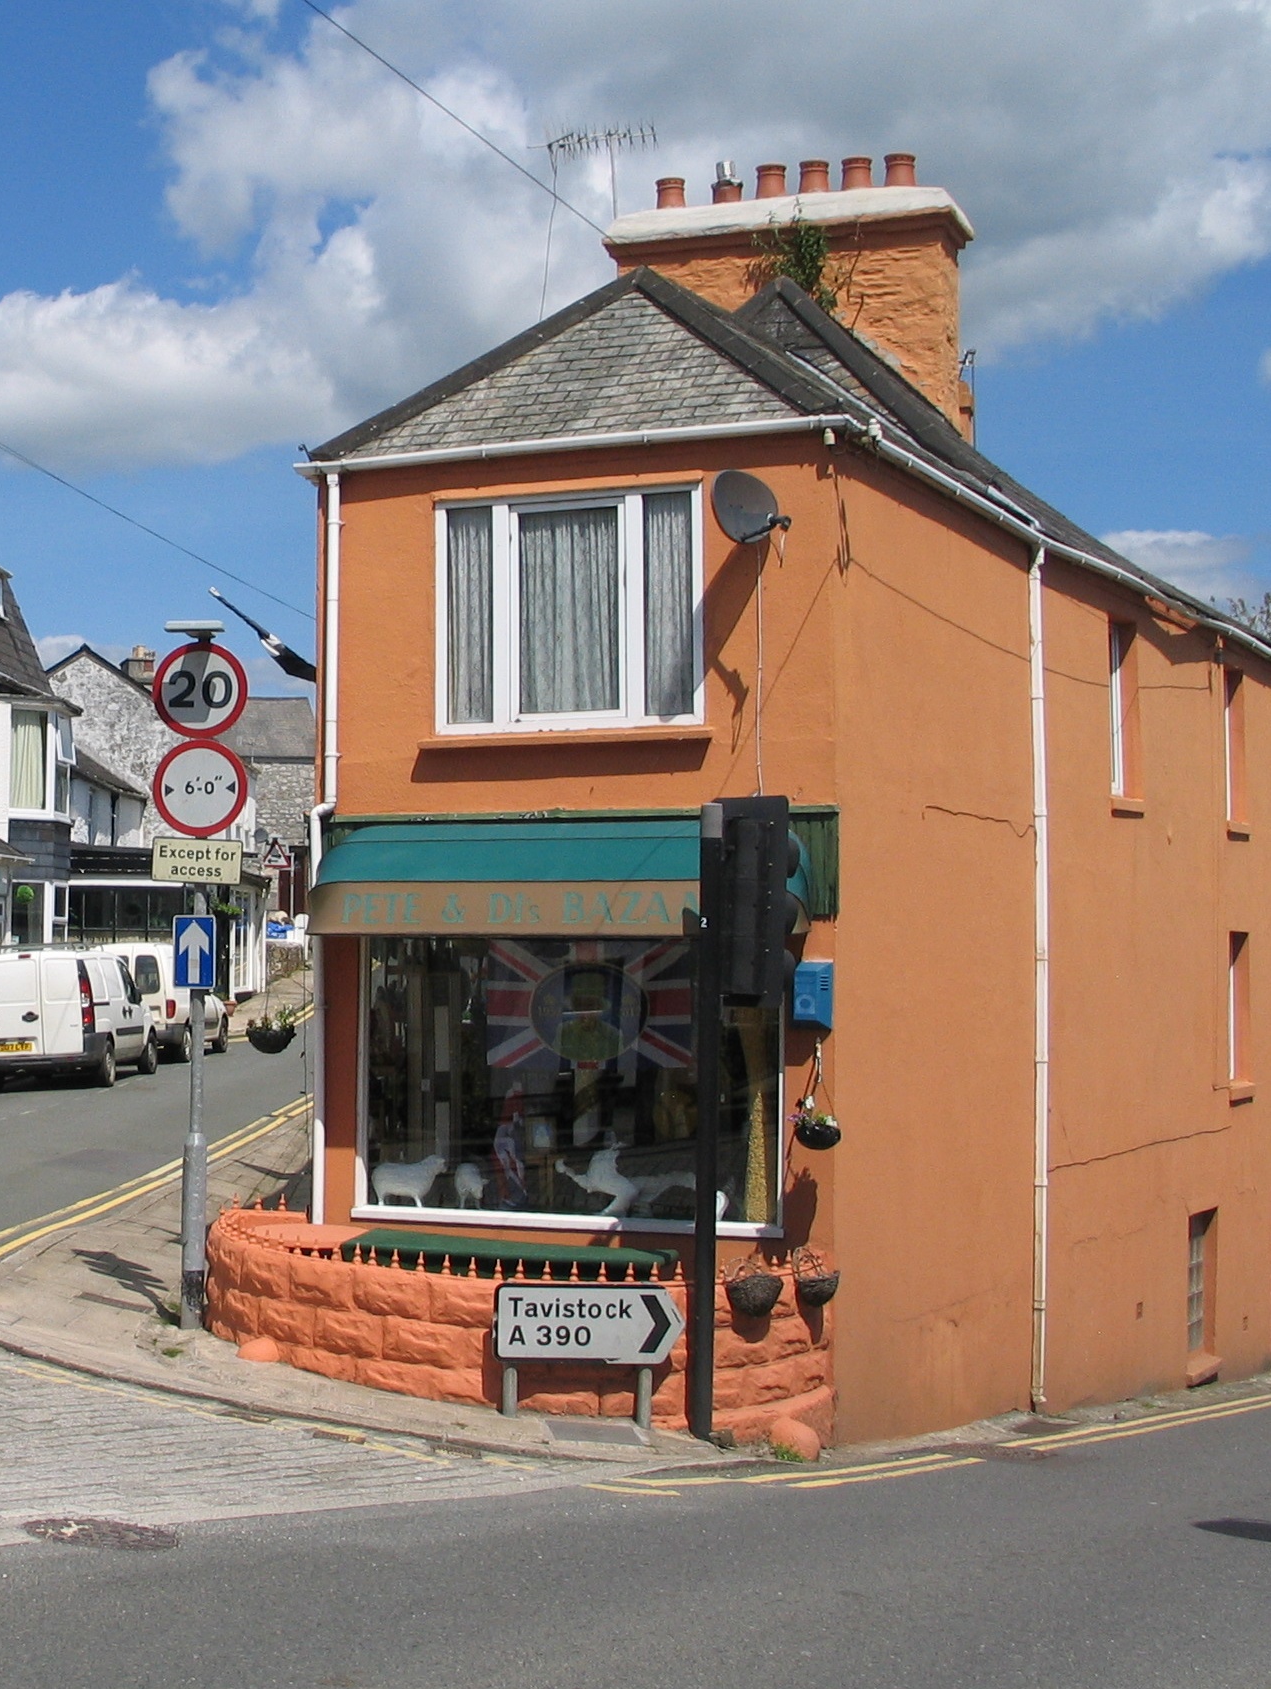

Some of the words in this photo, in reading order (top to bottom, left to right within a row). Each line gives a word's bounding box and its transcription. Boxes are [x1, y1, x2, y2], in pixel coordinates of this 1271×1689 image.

[168, 670, 233, 709] 20
[158, 845, 212, 863] Except
[215, 848, 237, 862] for
[171, 864, 222, 878] access
[341, 892, 423, 925] PETE
[441, 892, 468, 924] &
[561, 891, 699, 925] BAZAA
[700, 916, 708, 928] 2
[508, 1297, 632, 1319] Tavistock
[508, 1325, 526, 1346] A
[536, 1325, 591, 1346] 390
